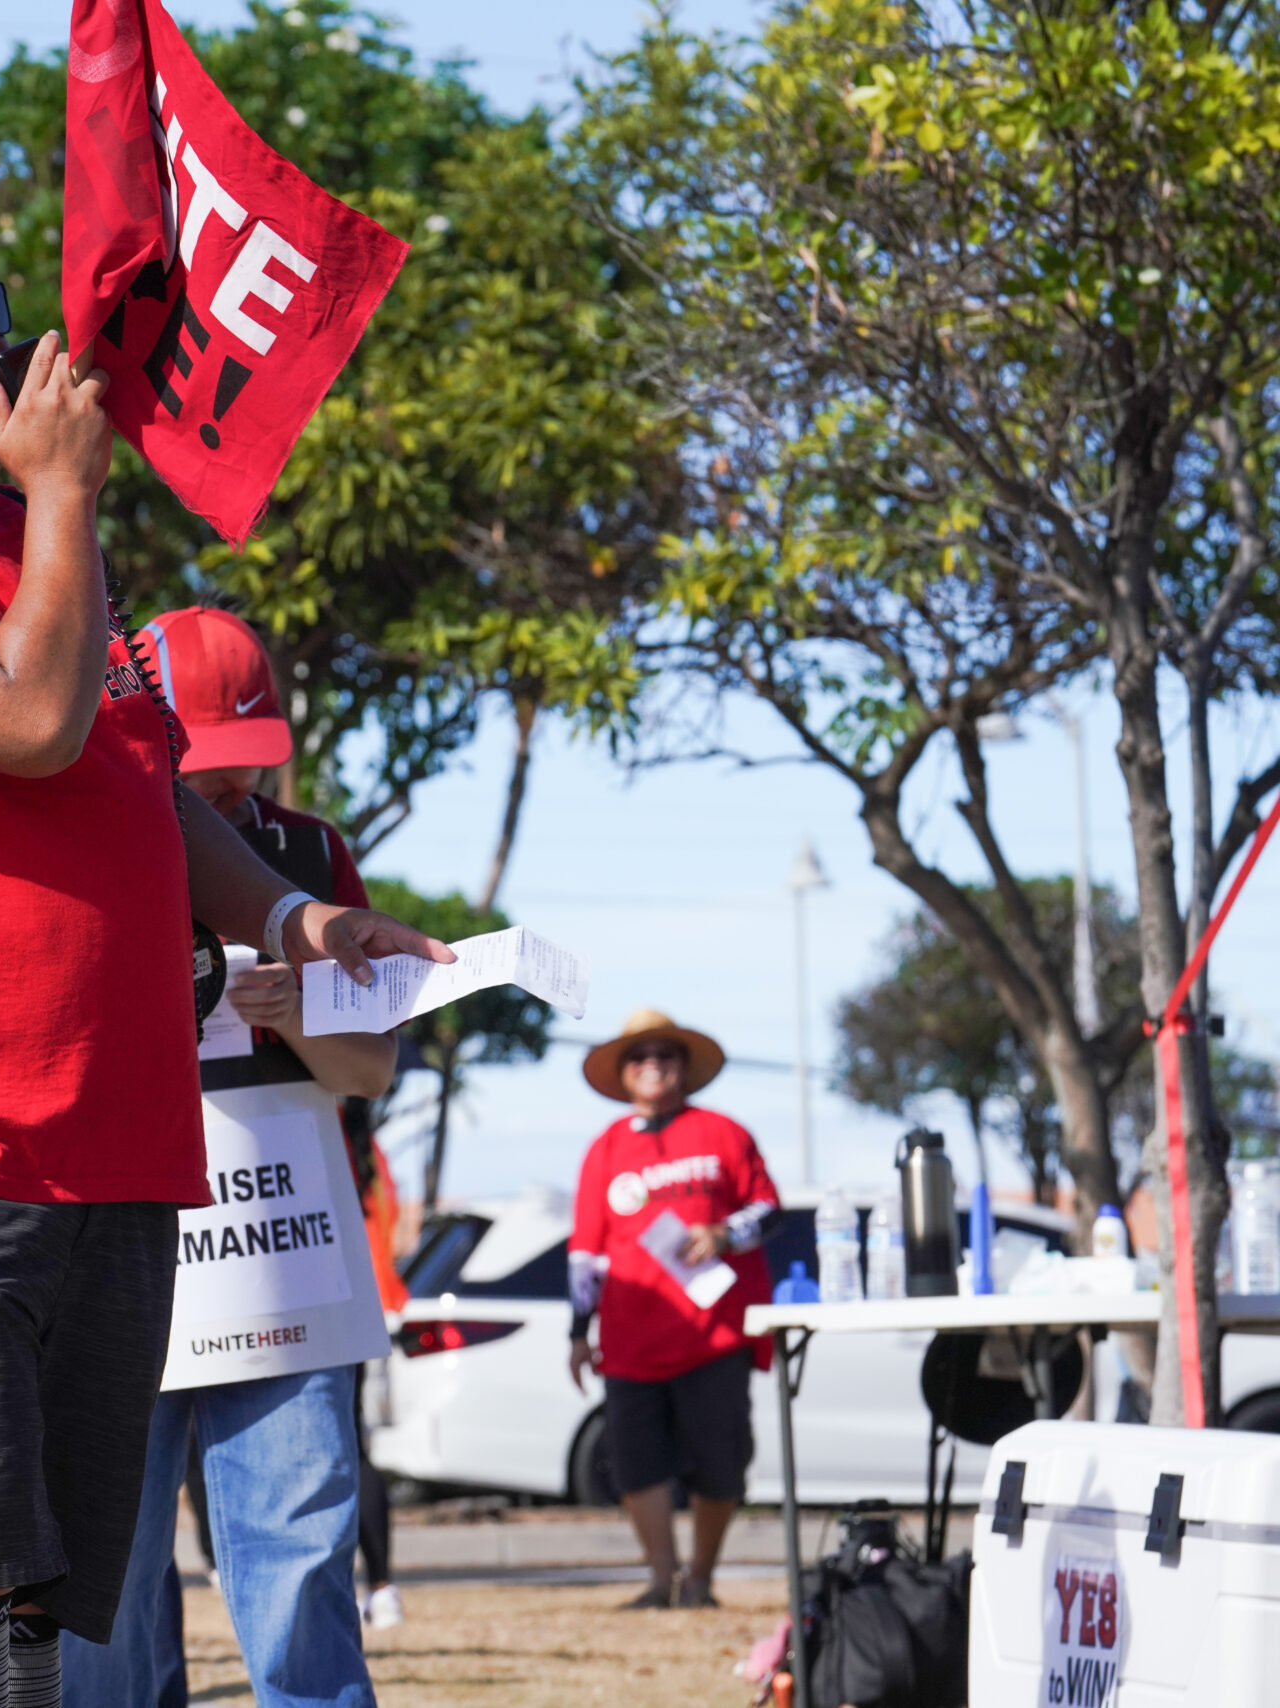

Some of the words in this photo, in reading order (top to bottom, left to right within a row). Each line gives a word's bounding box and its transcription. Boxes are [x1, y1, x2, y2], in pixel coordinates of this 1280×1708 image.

[211, 1162, 295, 1205] ISER
[176, 1211, 335, 1266] MANENTE
[1054, 1567, 1118, 1650] YES
[1048, 1667, 1065, 1705] to
